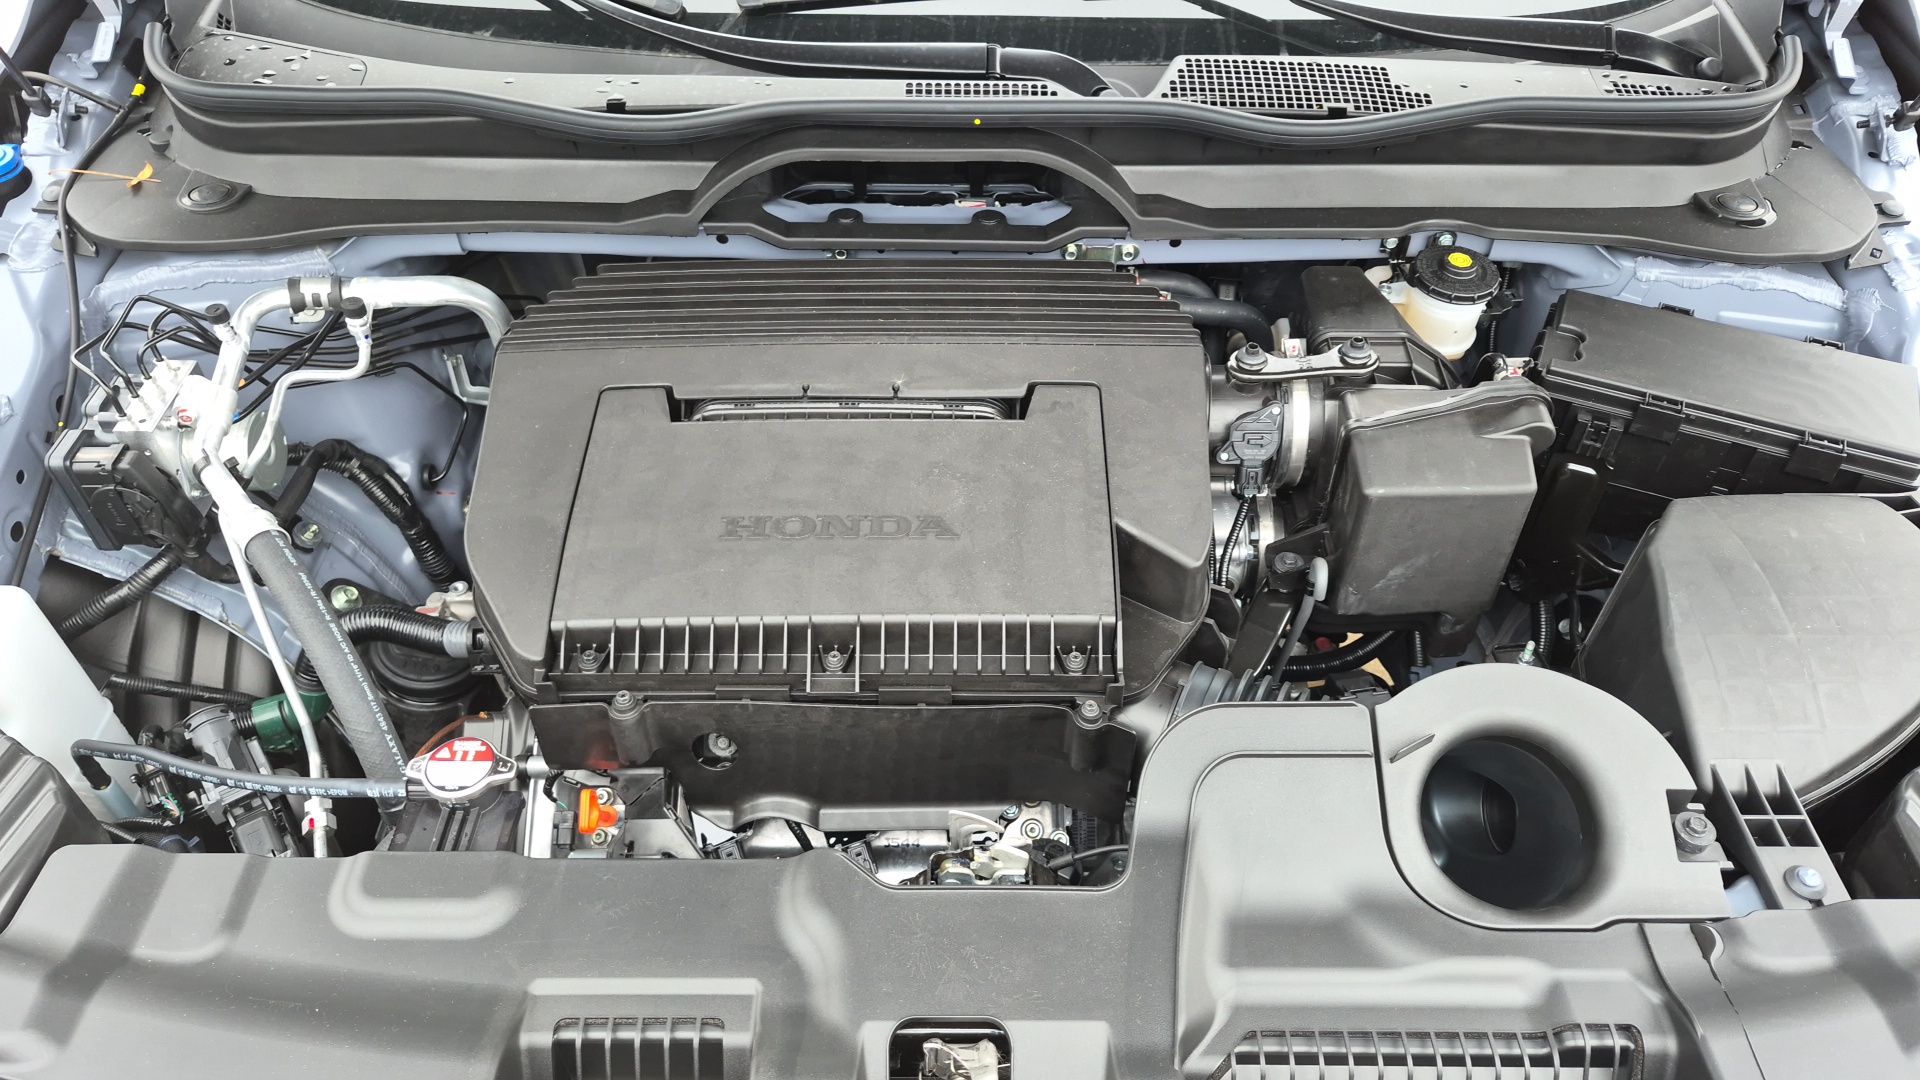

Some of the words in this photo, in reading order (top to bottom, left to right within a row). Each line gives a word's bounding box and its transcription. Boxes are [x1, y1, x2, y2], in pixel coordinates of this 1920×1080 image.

[719, 514, 960, 541] HONDA
[328, 622, 344, 642] HOSE
[375, 712, 388, 731] 4843
[384, 733, 407, 774] GALAXY
[883, 837, 921, 848] J544
